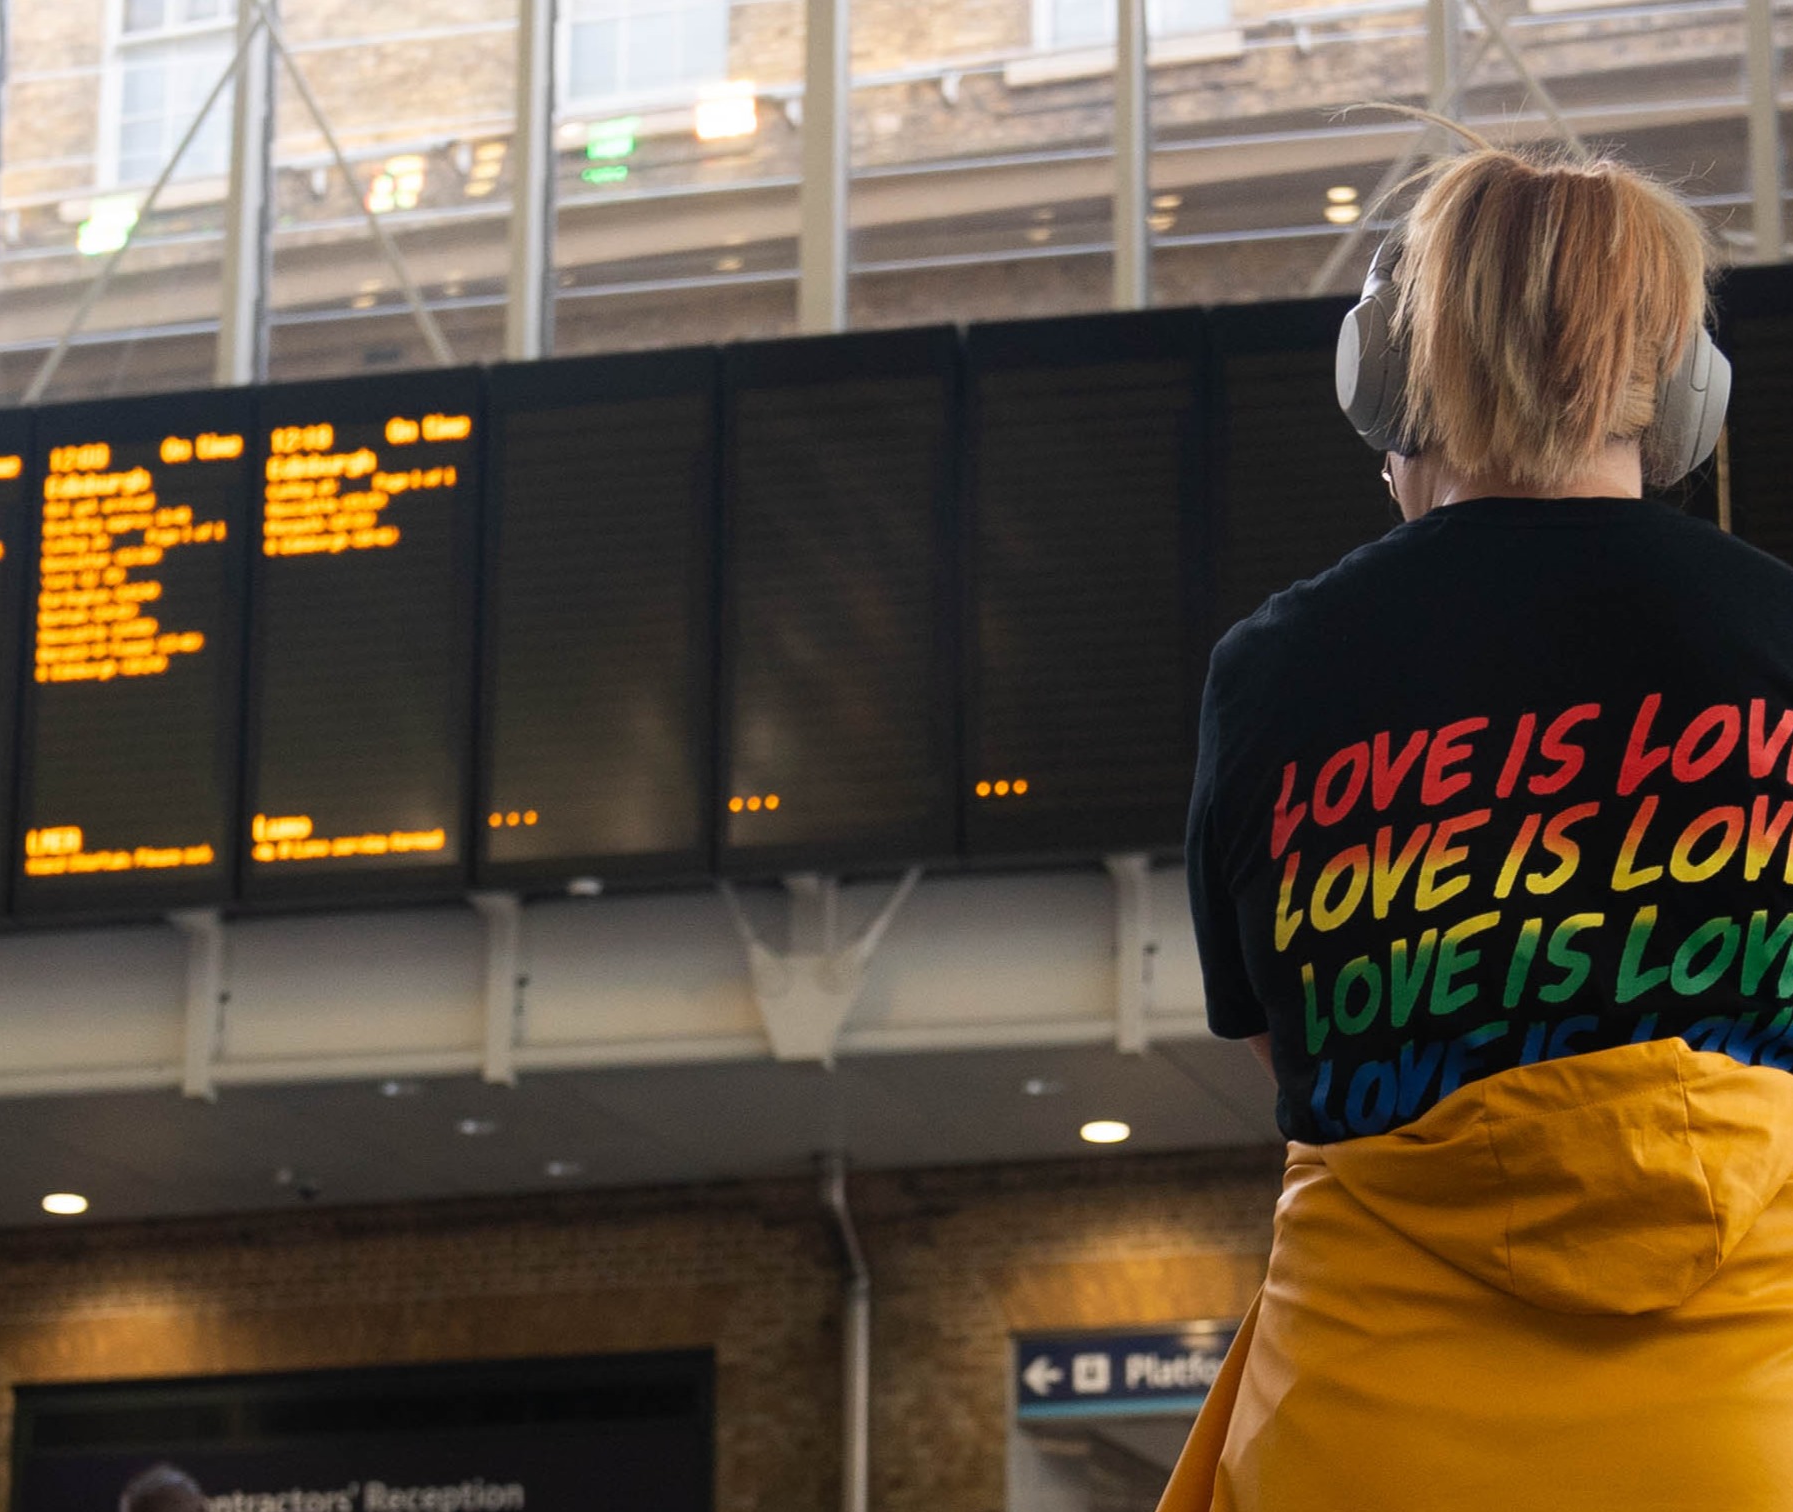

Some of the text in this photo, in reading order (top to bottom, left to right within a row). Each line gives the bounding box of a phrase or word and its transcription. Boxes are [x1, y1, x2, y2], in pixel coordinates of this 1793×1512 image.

[1271, 717, 1490, 860] LOVE
[1495, 703, 1601, 799] IS
[1273, 809, 1491, 952] LOVE
[1494, 802, 1601, 900] IS
[1301, 911, 1500, 1055] LOVE
[1502, 912, 1605, 1009] IS
[1125, 1352, 1221, 1390] Platfo
